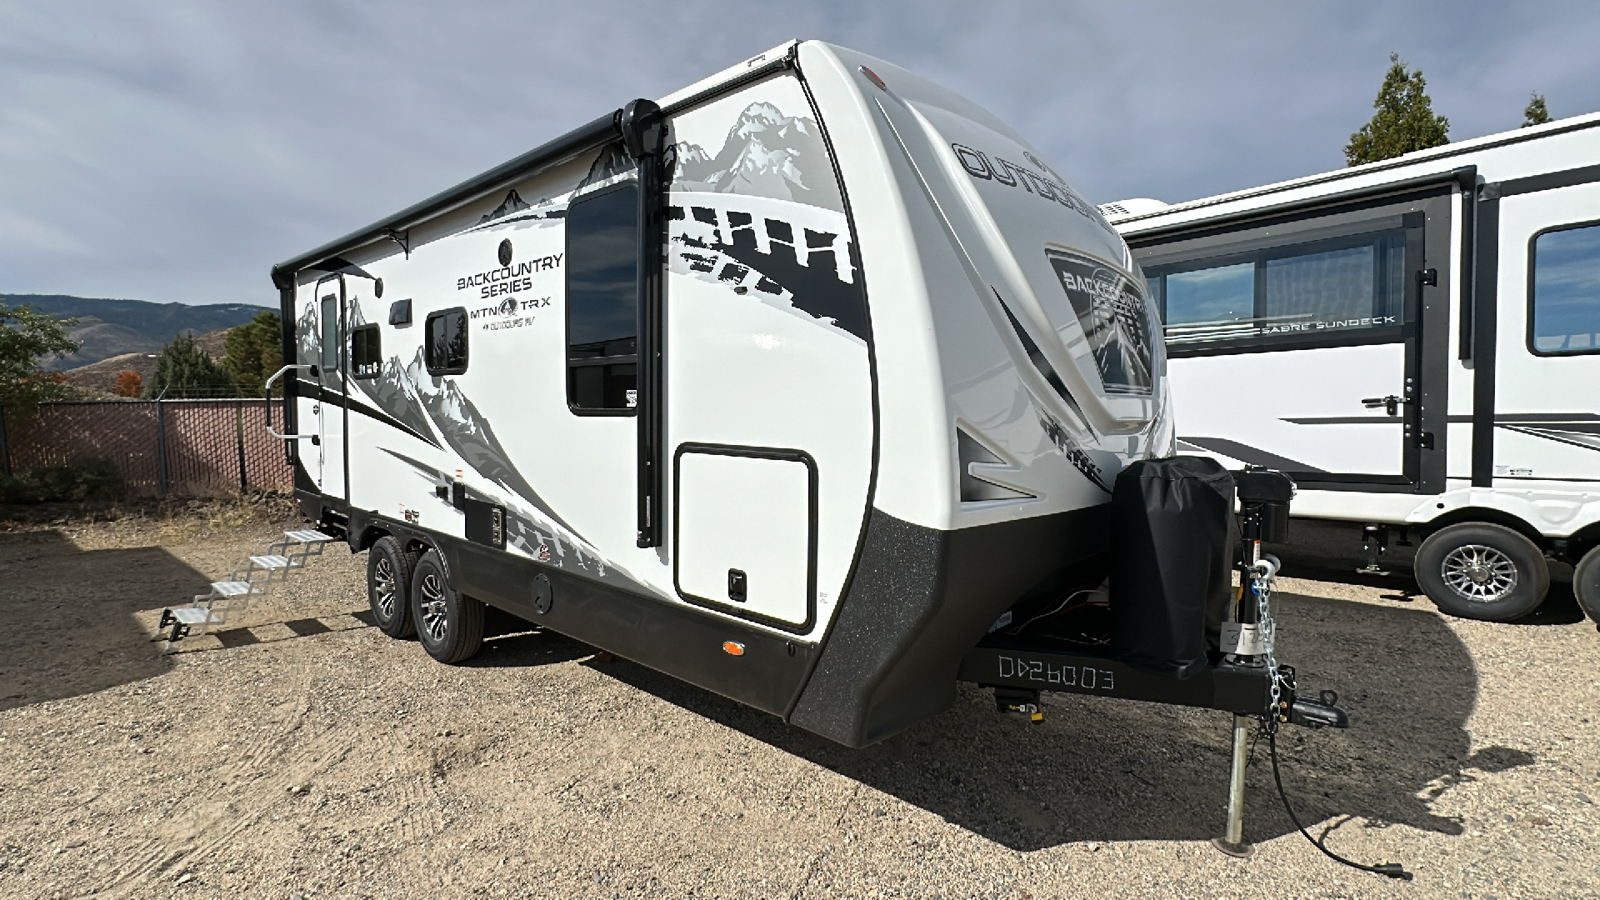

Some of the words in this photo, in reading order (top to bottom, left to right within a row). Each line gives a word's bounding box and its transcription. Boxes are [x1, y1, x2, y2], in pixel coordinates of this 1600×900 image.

[457, 252, 564, 291] BACKCOUNTRY
[480, 277, 533, 299] SERIES
[470, 306, 498, 319] MTN
[520, 296, 551, 311] TRX
[1261, 323, 1310, 334] SABRE
[1316, 315, 1396, 329] SUNDECK
